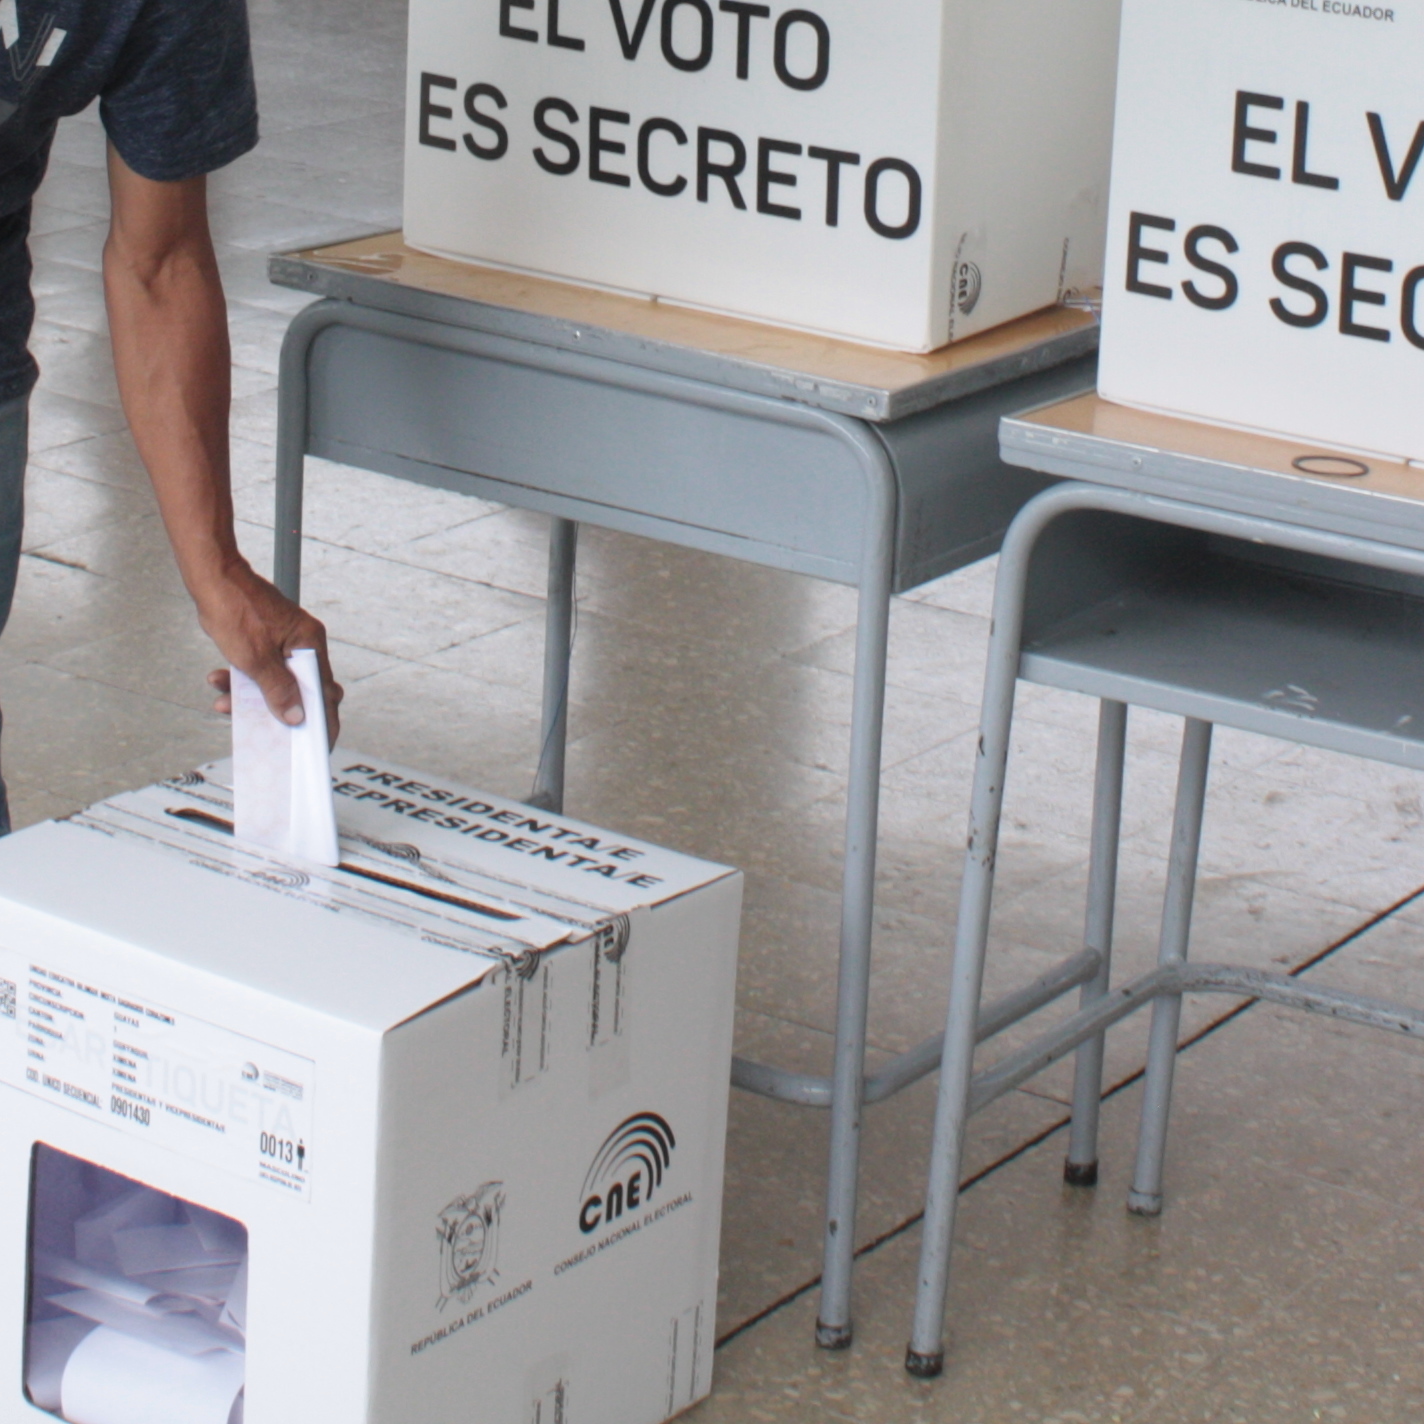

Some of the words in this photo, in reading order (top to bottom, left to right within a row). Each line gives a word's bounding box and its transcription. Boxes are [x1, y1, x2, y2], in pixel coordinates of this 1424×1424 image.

[419, 71, 509, 162] ES
[532, 96, 923, 241] SECRETO
[1231, 89, 1340, 192] EL
[1125, 210, 1240, 312] ES
[329, 776, 665, 889] EPRESIDENTA/E
[342, 763, 646, 863] PRESIDENTA/E
[110, 1094, 151, 1127] 0901430
[260, 1131, 294, 1164] 0013
[553, 1244, 597, 1276] CONSEJO
[597, 1220, 642, 1253] NACIONAL
[643, 1191, 694, 1227] ELECTORAL
[579, 1170, 641, 1234] CNE
[410, 1318, 465, 1356] REPÚBLICA
[466, 1307, 485, 1326] DEL
[486, 1279, 533, 1314] ECUADOR
